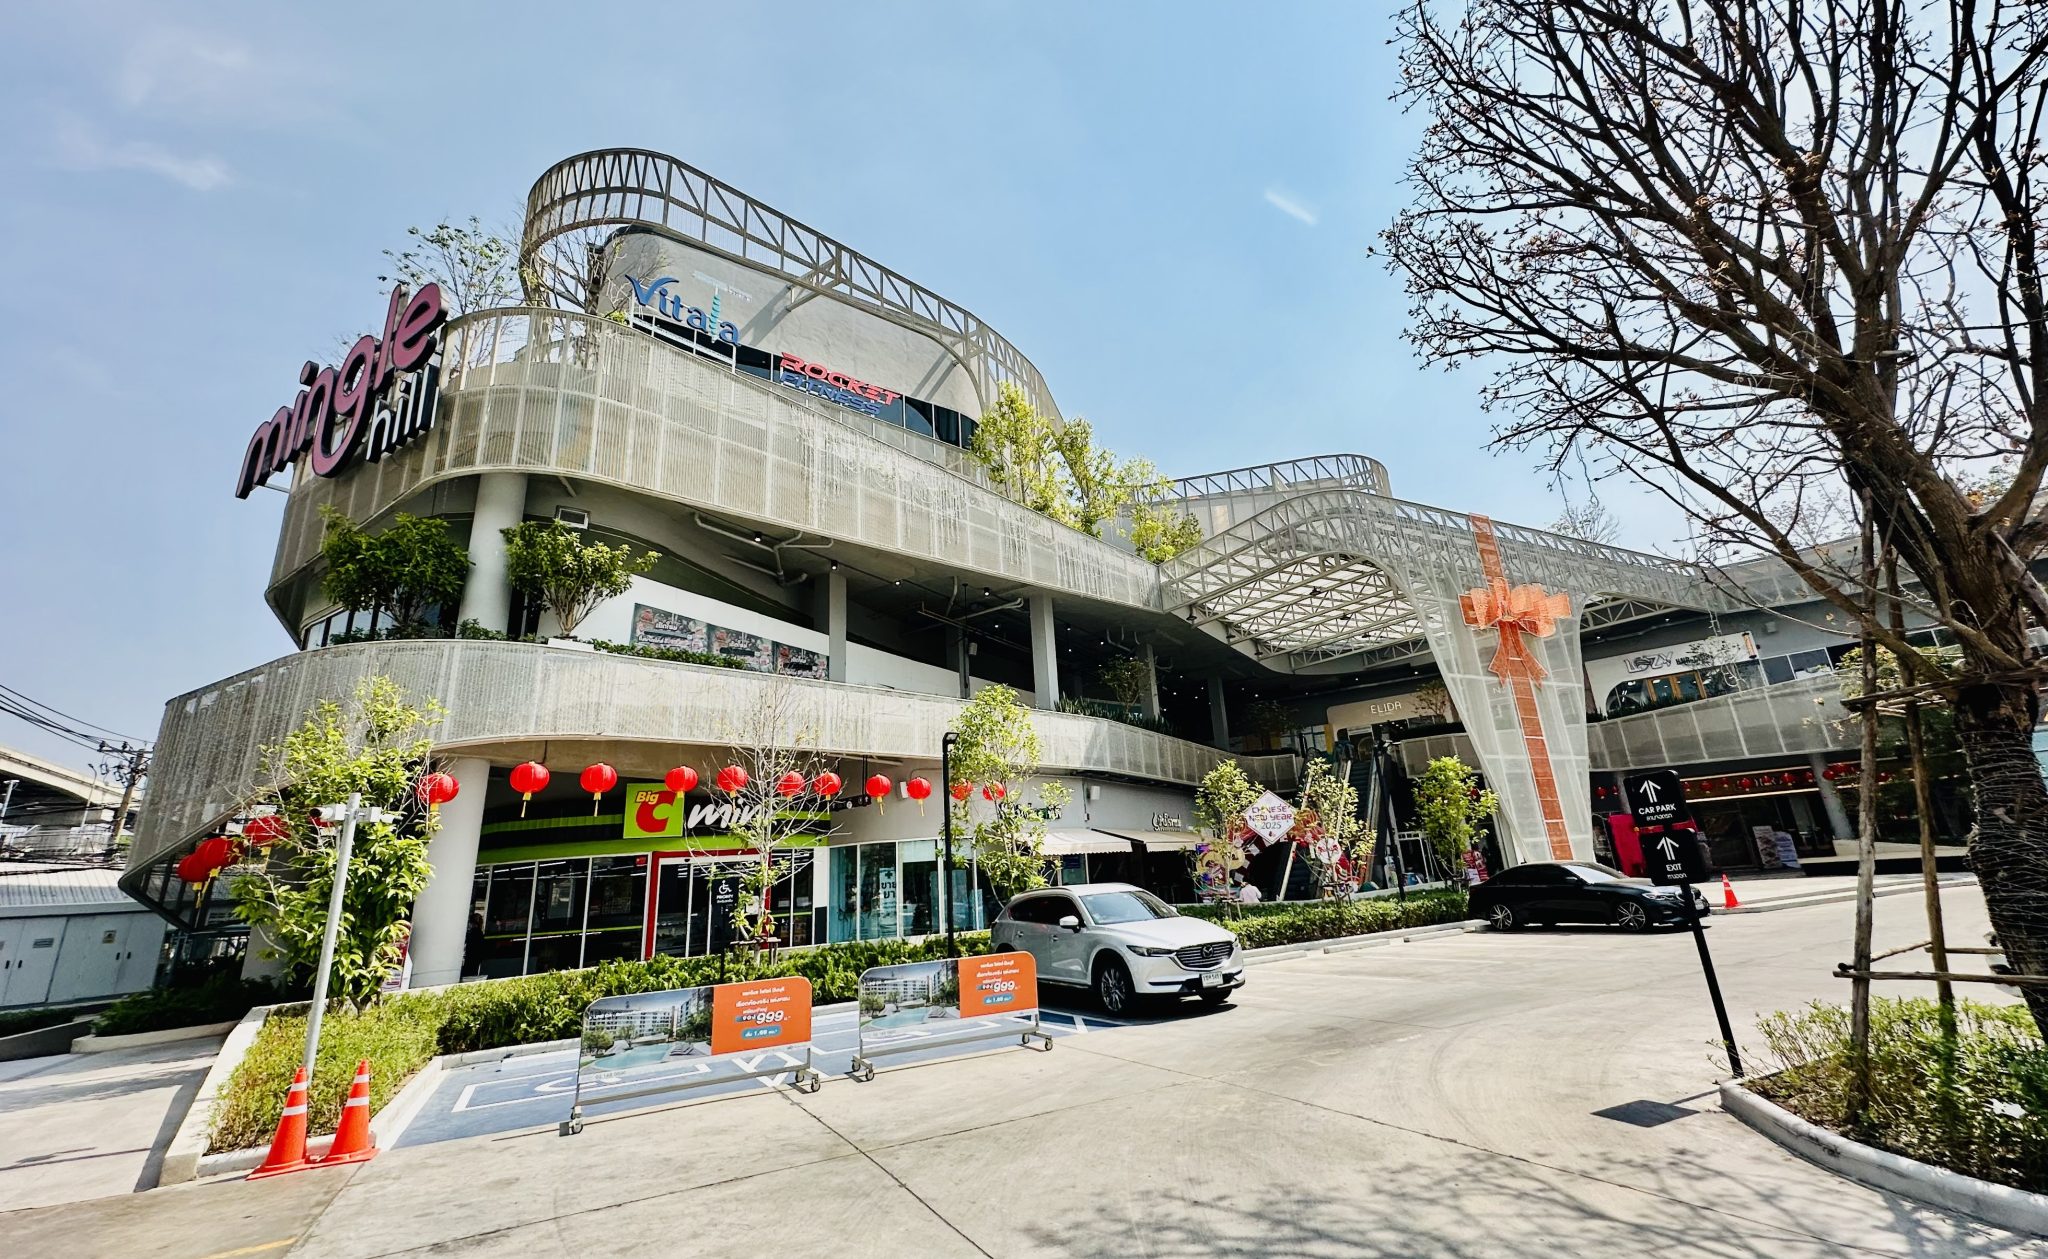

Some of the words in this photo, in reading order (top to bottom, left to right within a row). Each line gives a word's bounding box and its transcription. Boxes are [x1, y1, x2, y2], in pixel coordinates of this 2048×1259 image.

[780, 352, 901, 406] ROCKET
[235, 282, 447, 499] mingle
[780, 371, 882, 415] FITNESS
[366, 363, 440, 463] hill
[1370, 700, 1402, 714] ELIDA
[635, 791, 660, 805] Big
[635, 790, 677, 833] C
[1639, 806, 1655, 815] CAR
[1656, 803, 1677, 812] PARK
[1260, 821, 1282, 830] 2025
[1665, 863, 1682, 872] EXIT
[755, 1010, 785, 1025] 999
